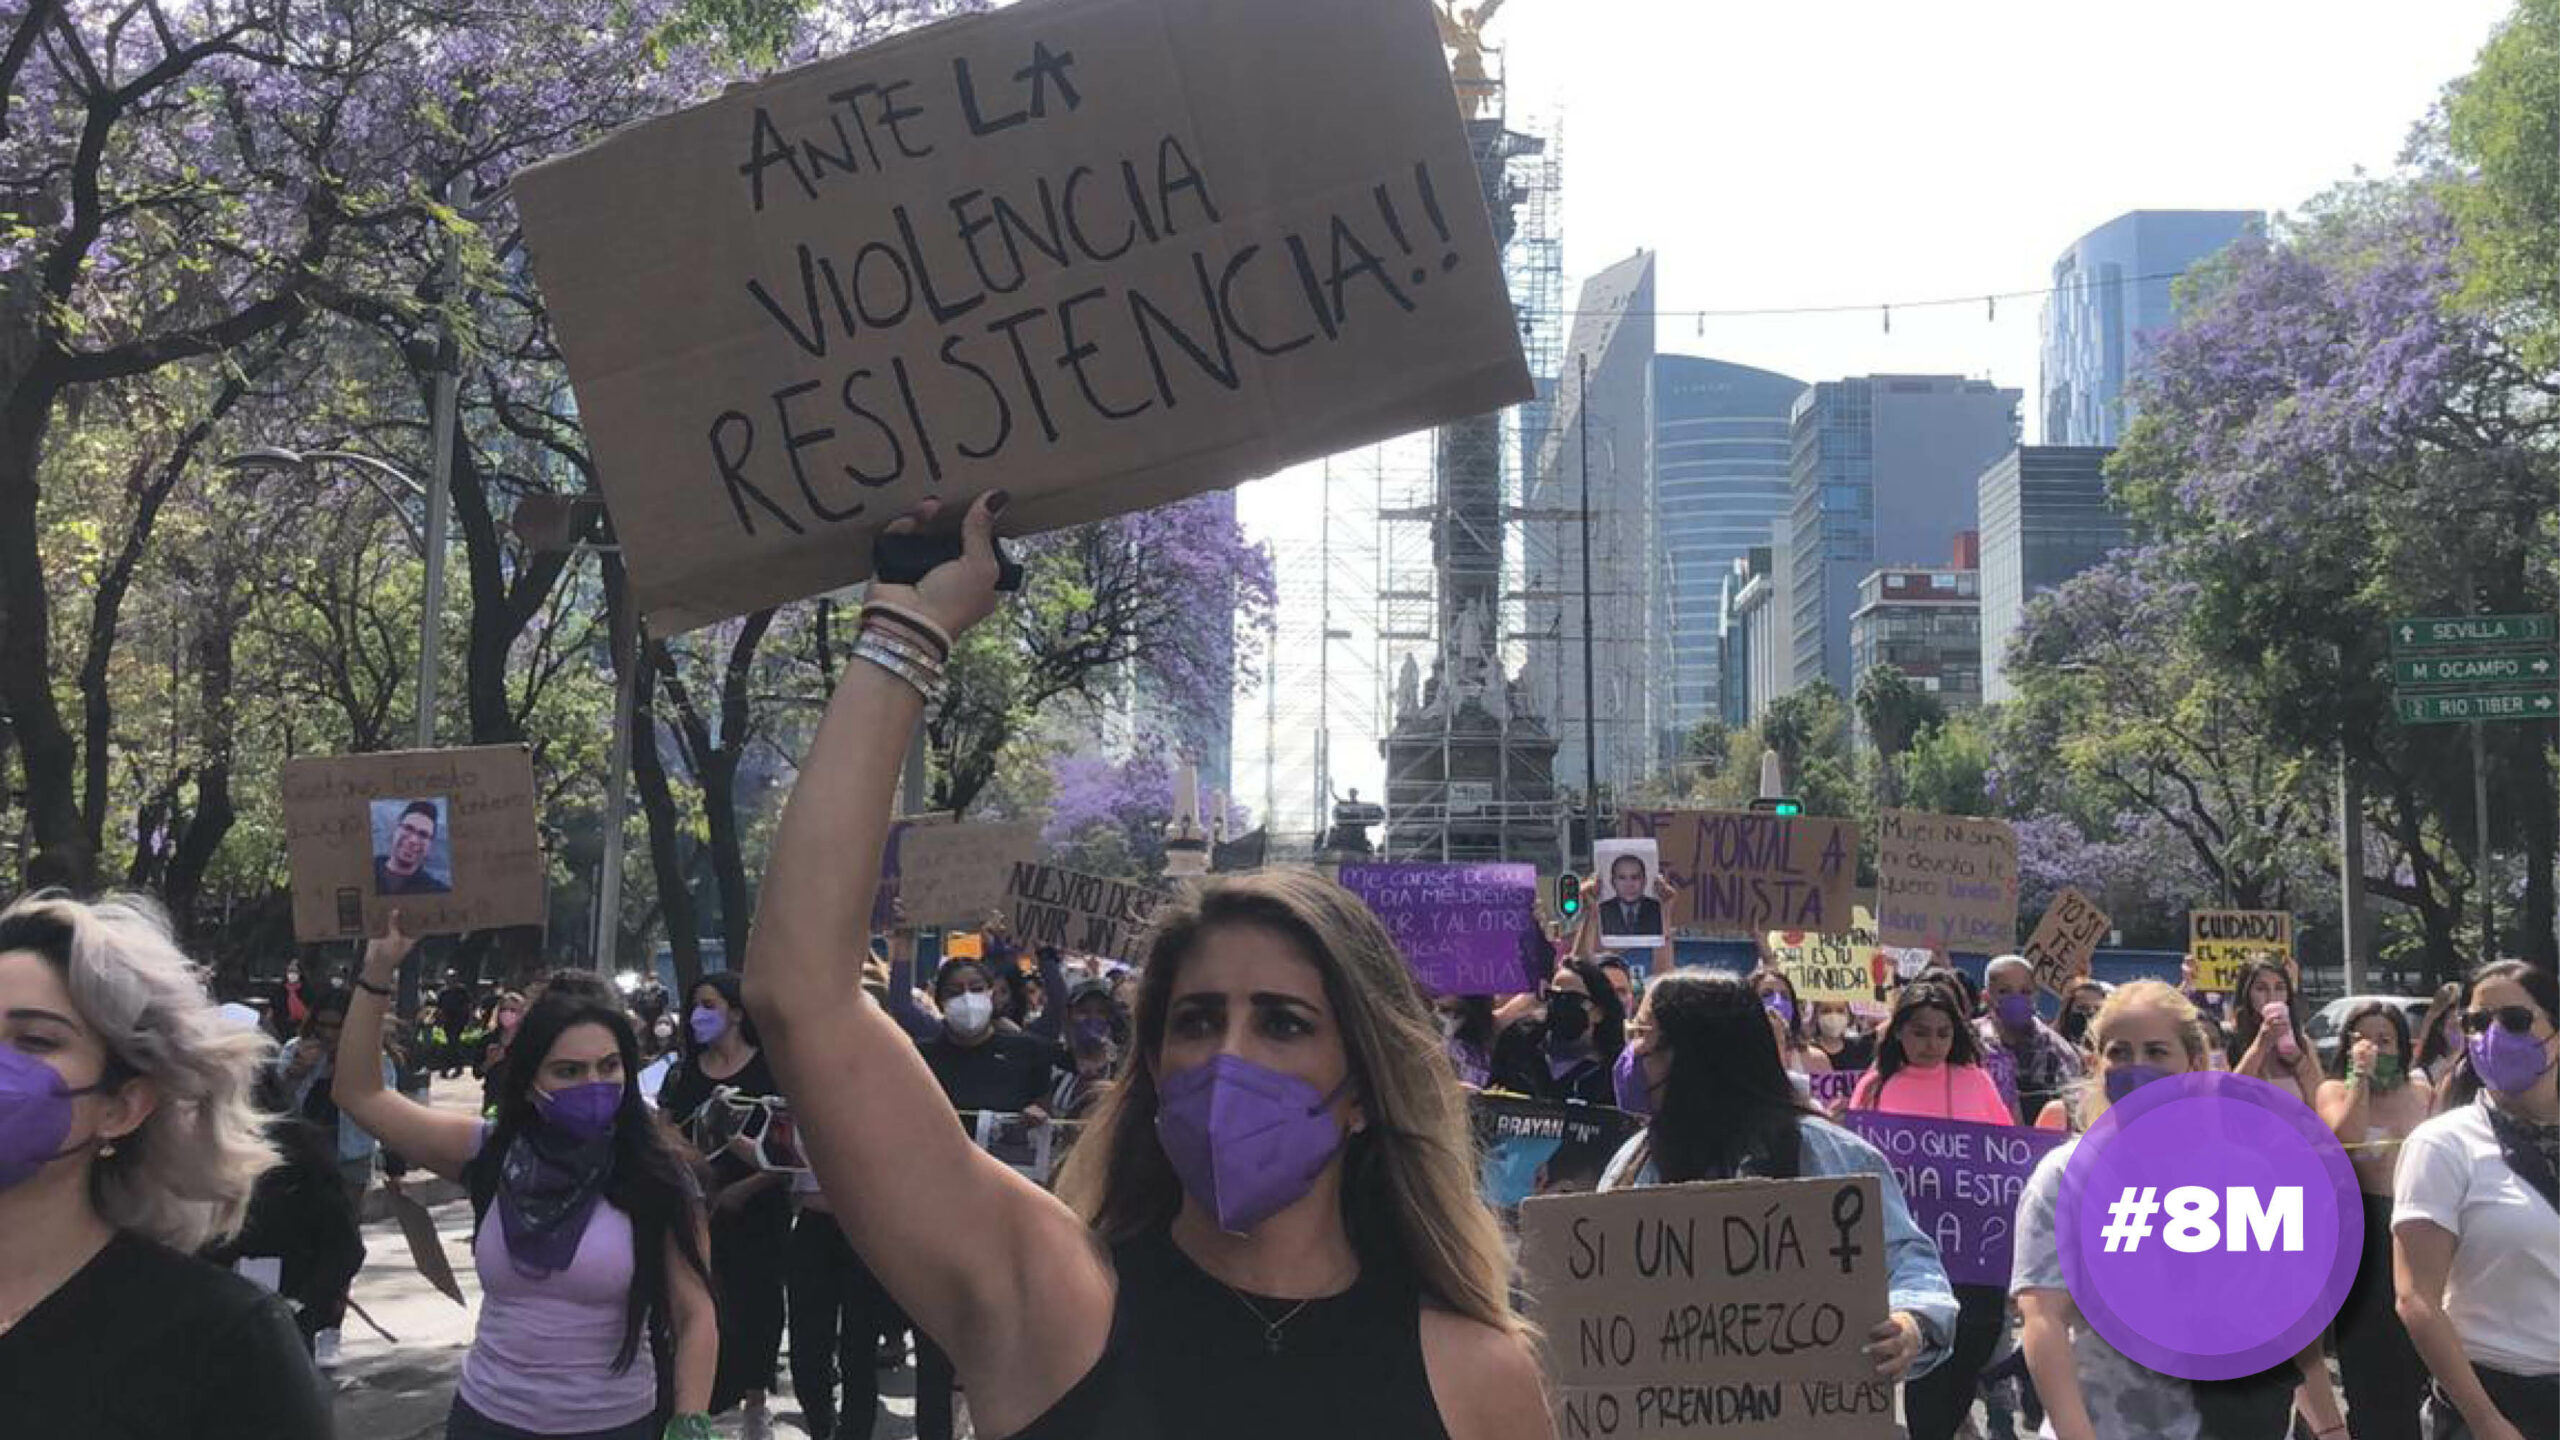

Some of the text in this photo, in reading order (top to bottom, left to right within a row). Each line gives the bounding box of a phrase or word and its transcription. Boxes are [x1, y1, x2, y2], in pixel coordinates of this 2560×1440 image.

[740, 40, 1081, 212] ANTE LA
[746, 134, 1222, 358] VIOLENCIA
[709, 160, 1461, 538] RESISTENCIA!!
[2433, 621, 2508, 640] SEVILLA
[2412, 660, 2519, 679] M OCAMPO
[2439, 699, 2468, 716] RIO
[2477, 697, 2524, 714] TIBER
[1694, 815, 1803, 876] MORTAL
[1819, 823, 1847, 878] A
[1008, 861, 1103, 914] NUESTRO
[1660, 861, 1825, 926] MINISTA
[1013, 901, 1070, 948] VIVIR
[1447, 911, 1473, 933] AL
[1811, 947, 1828, 966] ES
[1834, 946, 1853, 965] TU
[2197, 945, 2217, 962] EL
[1497, 1113, 1565, 1139] BRAYAN
[1920, 1129, 1972, 1160] QUE
[1985, 1135, 2031, 1166] NO
[1568, 1203, 1806, 1280] SI UN DÍA
[1580, 1302, 1846, 1369] NO APAREZCO
[1564, 1379, 1890, 1439] NO PRENDAN VELAS
